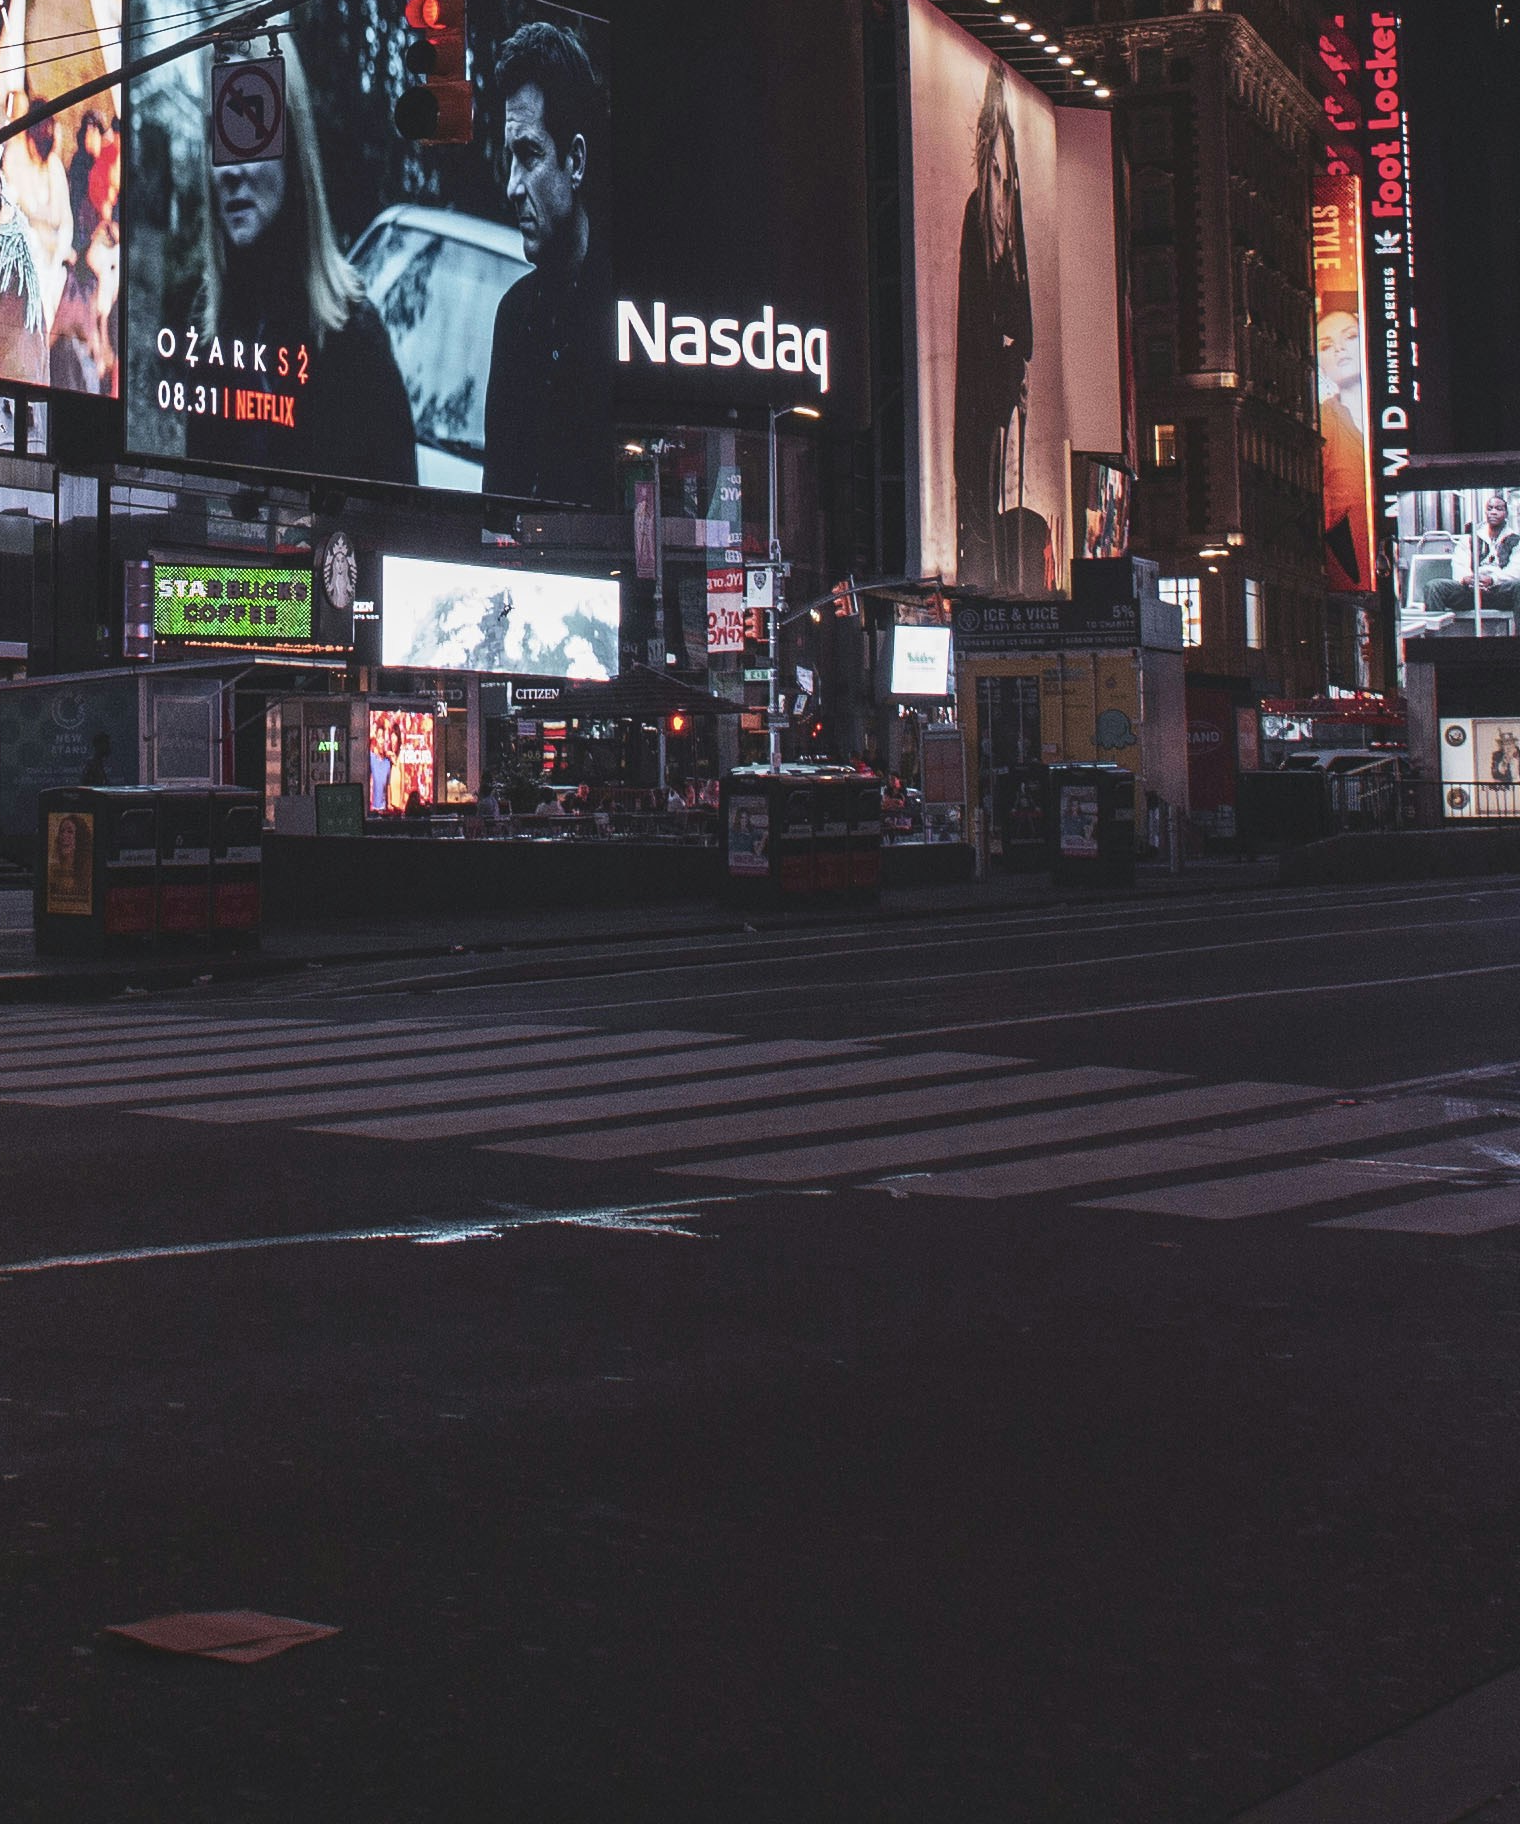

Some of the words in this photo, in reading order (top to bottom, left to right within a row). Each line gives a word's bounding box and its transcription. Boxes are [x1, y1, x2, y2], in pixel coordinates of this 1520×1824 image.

[1365, 12, 1402, 131] Locker
[1370, 140, 1403, 218] Foot
[1313, 204, 1342, 271] STYLE
[157, 324, 268, 375] OZARK
[616, 299, 829, 394] Nasdaq
[157, 378, 219, 417] 08.31
[233, 388, 295, 429] NETFLIX
[157, 579, 308, 601] STARBUCKS
[184, 603, 278, 625] COFFEE
[983, 608, 1007, 622] ICE
[1010, 607, 1022, 621] &
[1025, 606, 1060, 621] VICE
[1112, 604, 1136, 619] 5%
[515, 688, 560, 700] CITIZEN
